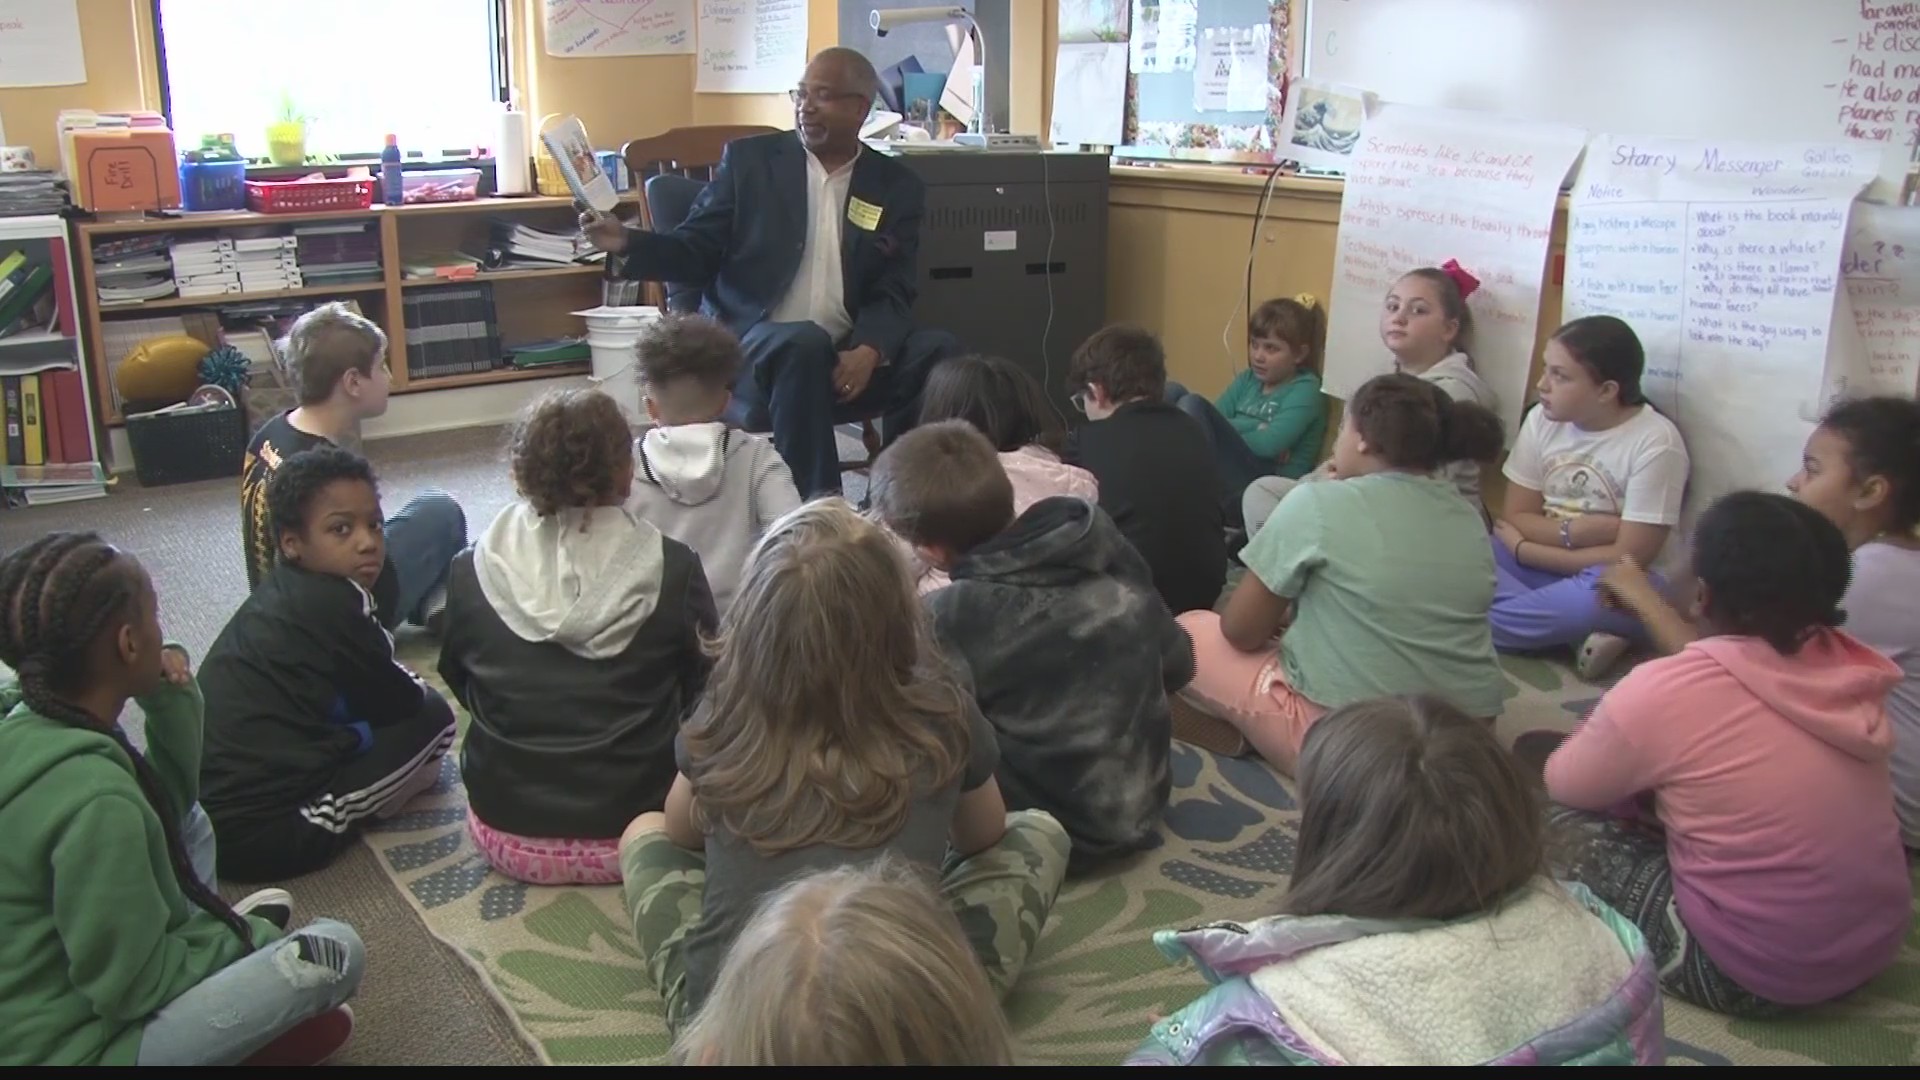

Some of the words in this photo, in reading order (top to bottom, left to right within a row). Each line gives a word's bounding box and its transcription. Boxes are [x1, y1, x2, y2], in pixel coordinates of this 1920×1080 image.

[1858, 31, 1875, 51] He
[1849, 54, 1886, 78] had
[1841, 78, 1858, 98] He
[1864, 81, 1903, 102] also
[1838, 101, 1898, 124] planets
[1367, 136, 1429, 158] Scientists
[1434, 144, 1460, 162] like
[104, 161, 119, 185] Fire
[1612, 145, 1676, 176] Starry
[1694, 147, 1783, 178] Messenger
[1802, 148, 1853, 165] Galileo
[118, 161, 134, 189] Drill
[1426, 163, 1446, 178] sea
[1453, 166, 1500, 180] because
[1504, 168, 1535, 189] they
[1588, 183, 1624, 199] Notice
[1450, 209, 1468, 228] the
[1696, 210, 1723, 223] What
[1728, 211, 1739, 222] is
[1744, 209, 1762, 221] the
[1767, 207, 1799, 222] book
[1801, 208, 1843, 230] mainly
[1697, 242, 1719, 260] Why
[1724, 245, 1733, 255] is
[1738, 239, 1764, 254] there
[1768, 244, 1776, 254] a
[1698, 261, 1719, 276] Why
[1723, 262, 1733, 271] is
[1736, 260, 1763, 273] there
[1768, 264, 1776, 273] a
[1702, 280, 1722, 297] Why
[1729, 281, 1742, 295] do
[1728, 320, 1738, 330] is
